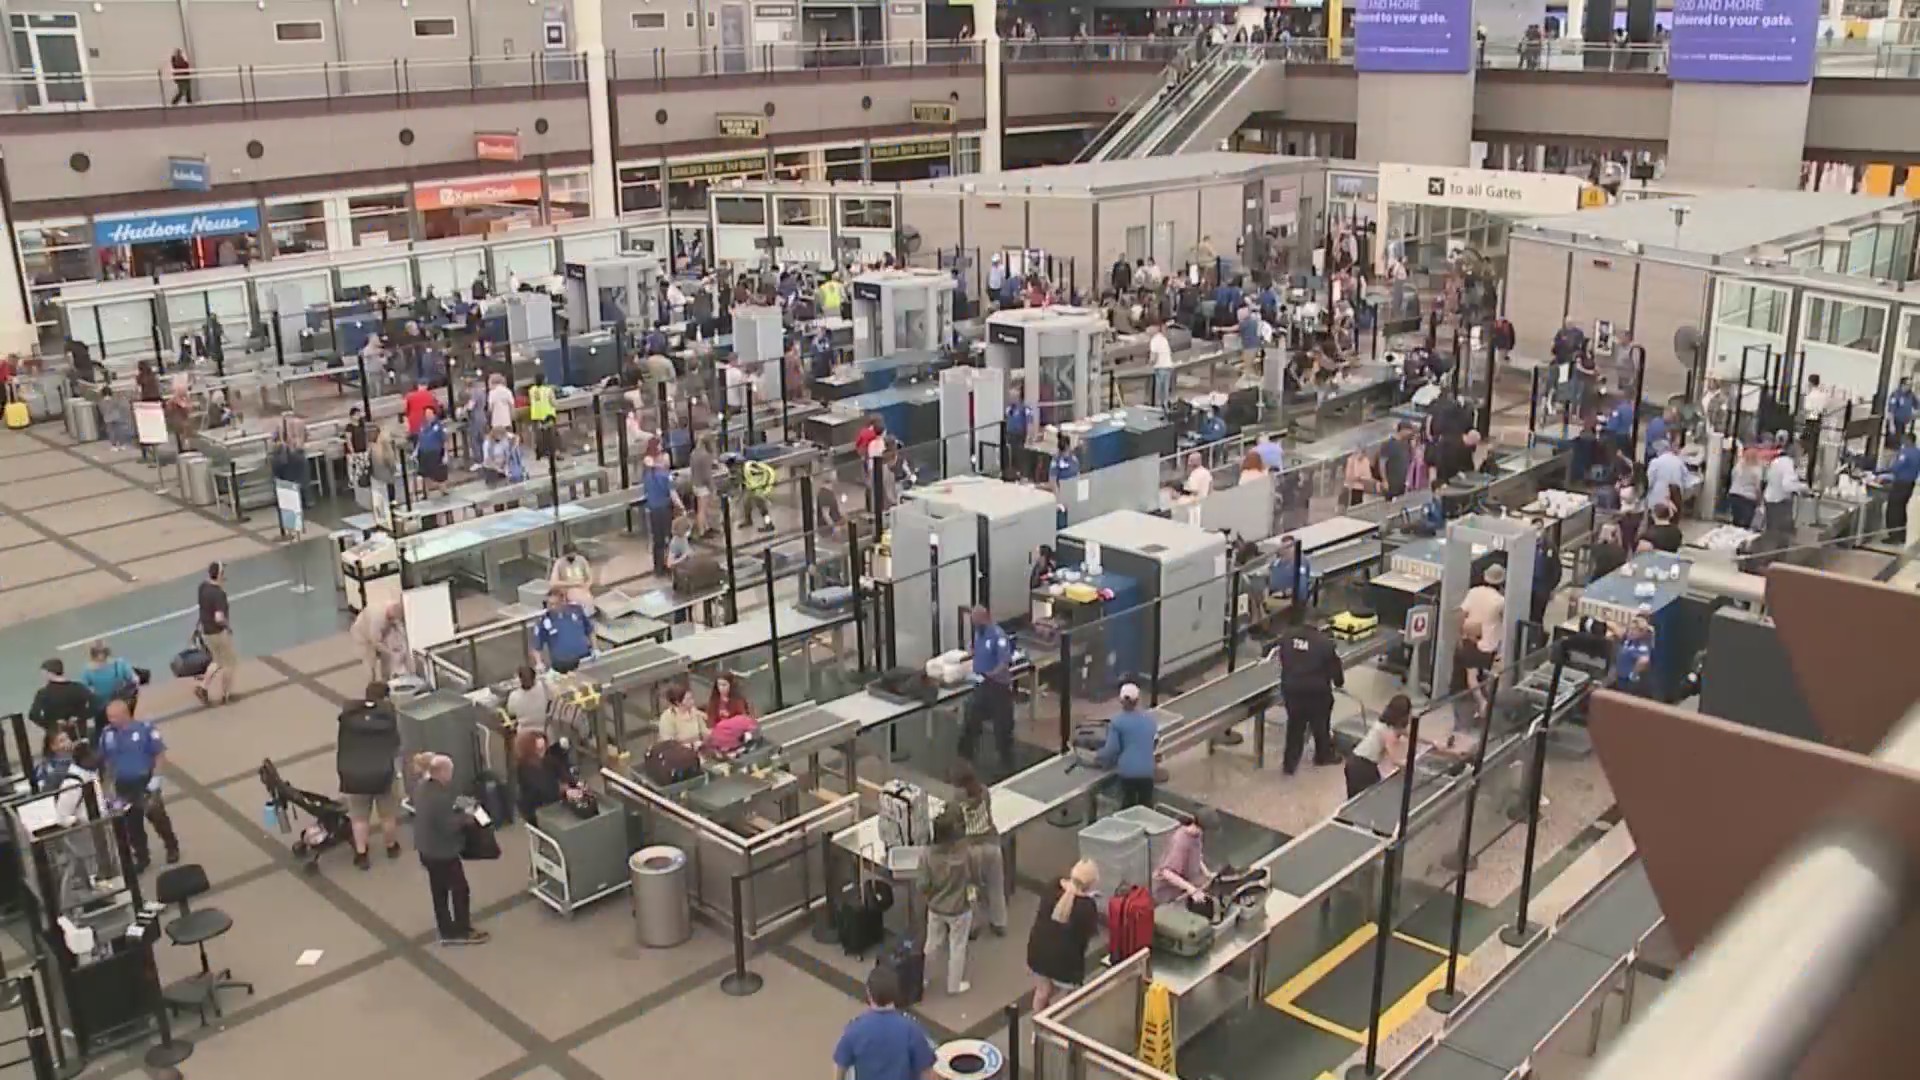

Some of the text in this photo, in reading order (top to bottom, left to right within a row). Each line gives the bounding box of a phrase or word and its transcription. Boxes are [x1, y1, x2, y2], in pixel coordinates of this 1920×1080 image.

[1724, 0, 1763, 11] MORE
[1393, 13, 1418, 25] your
[1713, 14, 1727, 26] to
[1729, 15, 1759, 29] your
[1762, 14, 1794, 29] gate.
[1450, 183, 1523, 200] to all Gates
[108, 216, 248, 241] Hudson News
[1293, 638, 1309, 651] TSA
